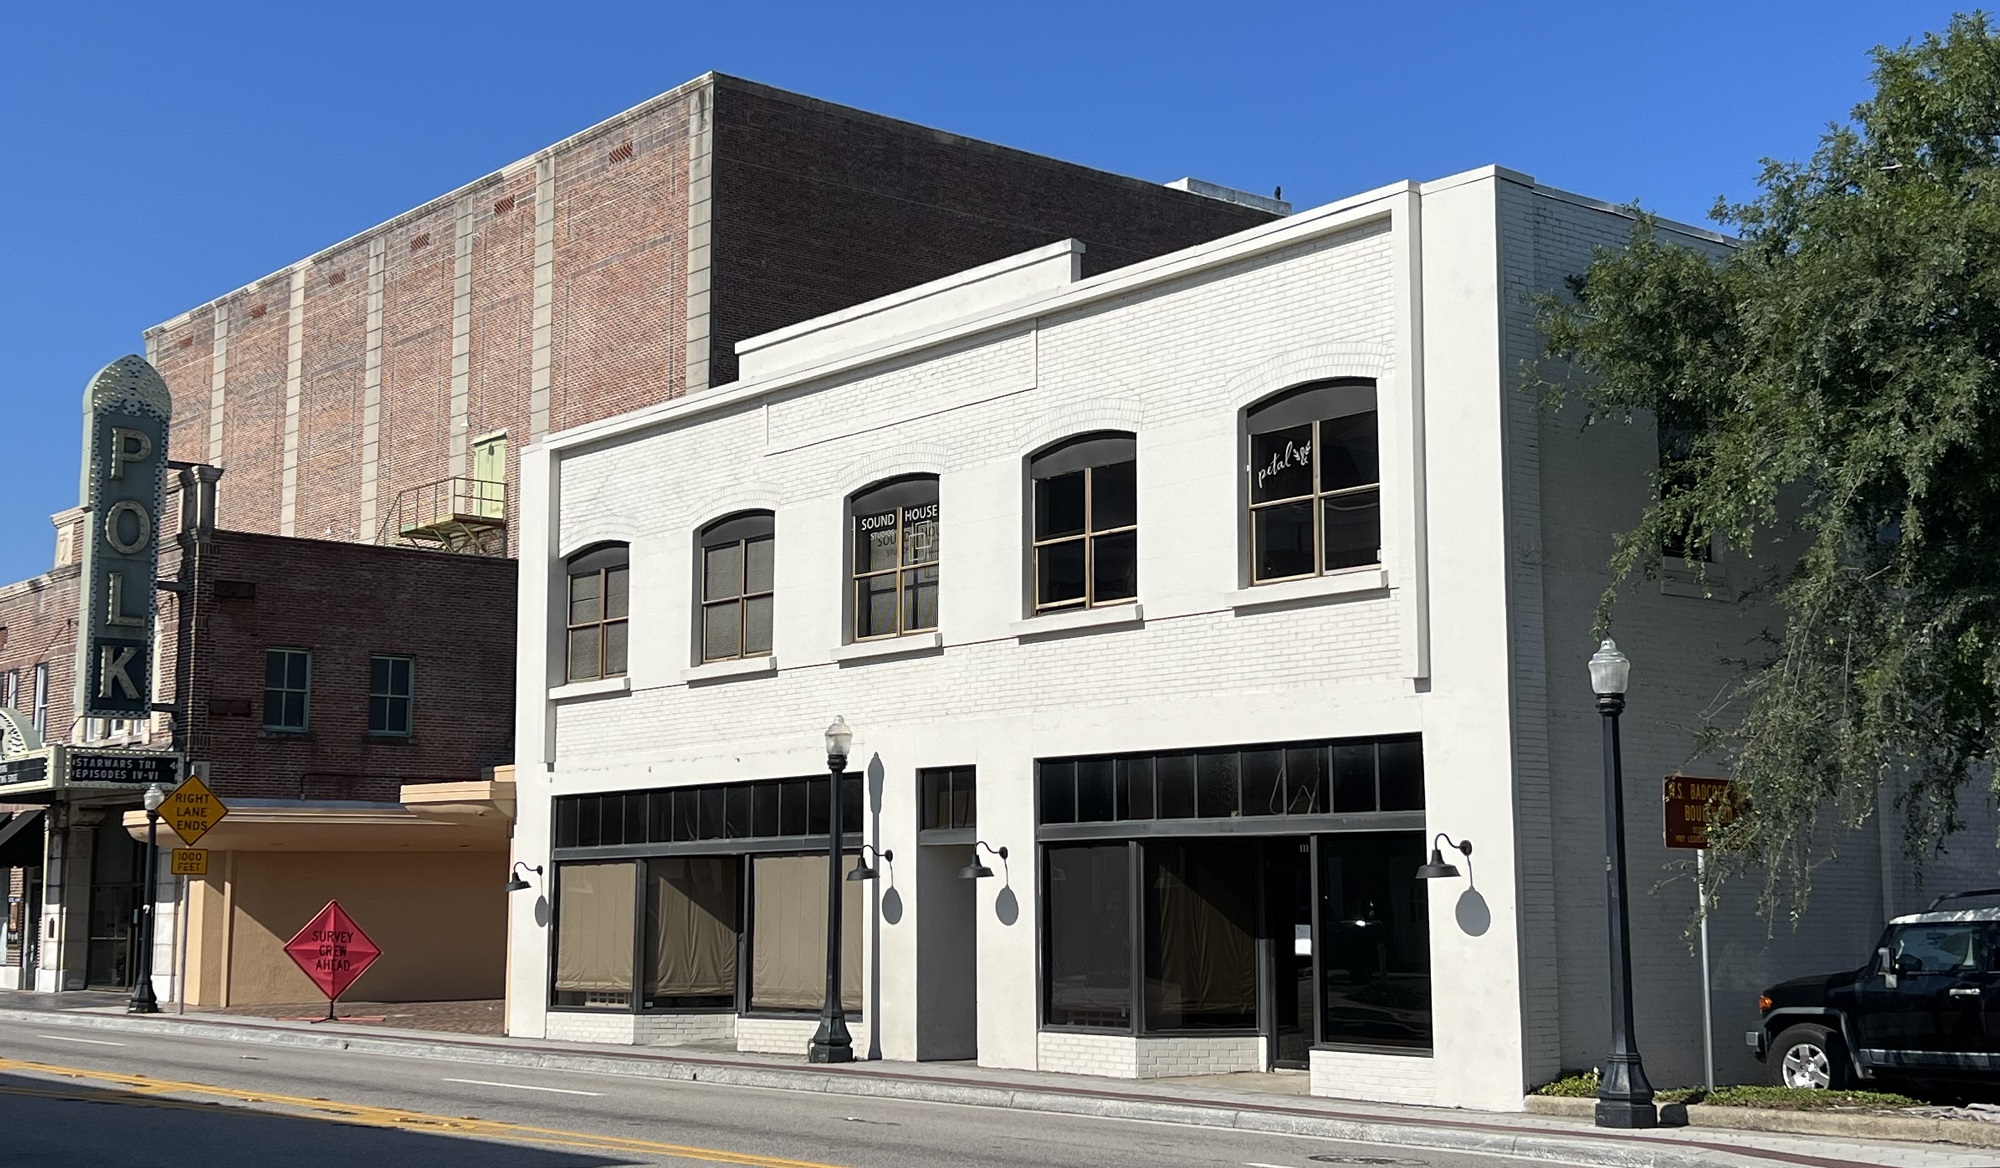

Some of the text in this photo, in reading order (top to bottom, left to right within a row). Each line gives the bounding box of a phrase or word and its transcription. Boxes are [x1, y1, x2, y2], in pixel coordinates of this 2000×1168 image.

[1258, 440, 1293, 489] petal
[861, 505, 938, 530] SOUND HOUSE
[98, 427, 151, 700] POLK
[75, 769, 127, 779] EPISODES
[175, 793, 210, 804] RIGHT
[1690, 784, 1728, 801] BADCOC
[176, 807, 207, 817] LANE
[176, 820, 207, 831] ENDS
[177, 852, 202, 861] 1000
[177, 862, 201, 872] FEET
[312, 930, 354, 943] SURVEY
[319, 944, 347, 957] CREW
[315, 959, 351, 971] AHEAD
